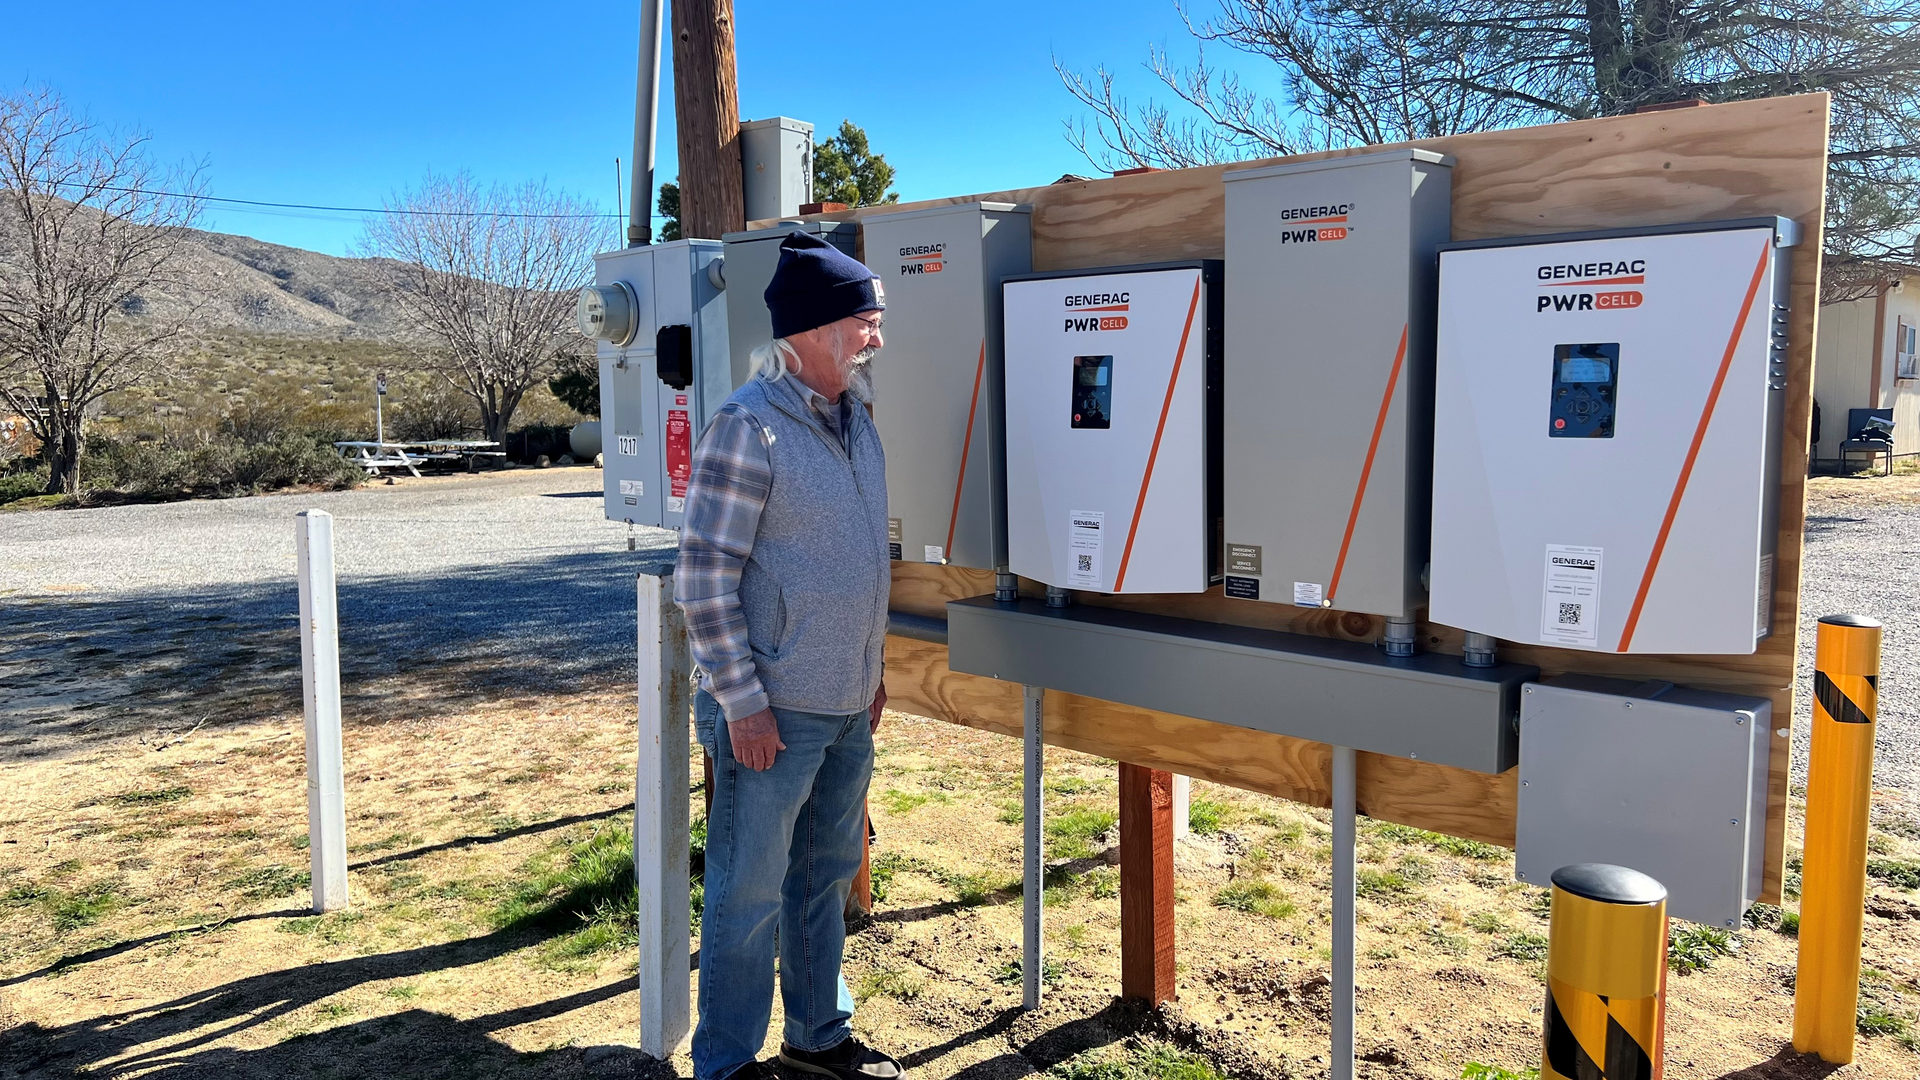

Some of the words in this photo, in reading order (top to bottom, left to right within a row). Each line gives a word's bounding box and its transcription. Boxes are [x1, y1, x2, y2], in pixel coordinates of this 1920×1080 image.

[1537, 259, 1646, 280] GENERAC
[1064, 292, 1130, 307] GENERAC
[619, 437, 636, 455] 1217
[1073, 519, 1100, 527] GENERAC
[1552, 557, 1596, 566] GENERAC
